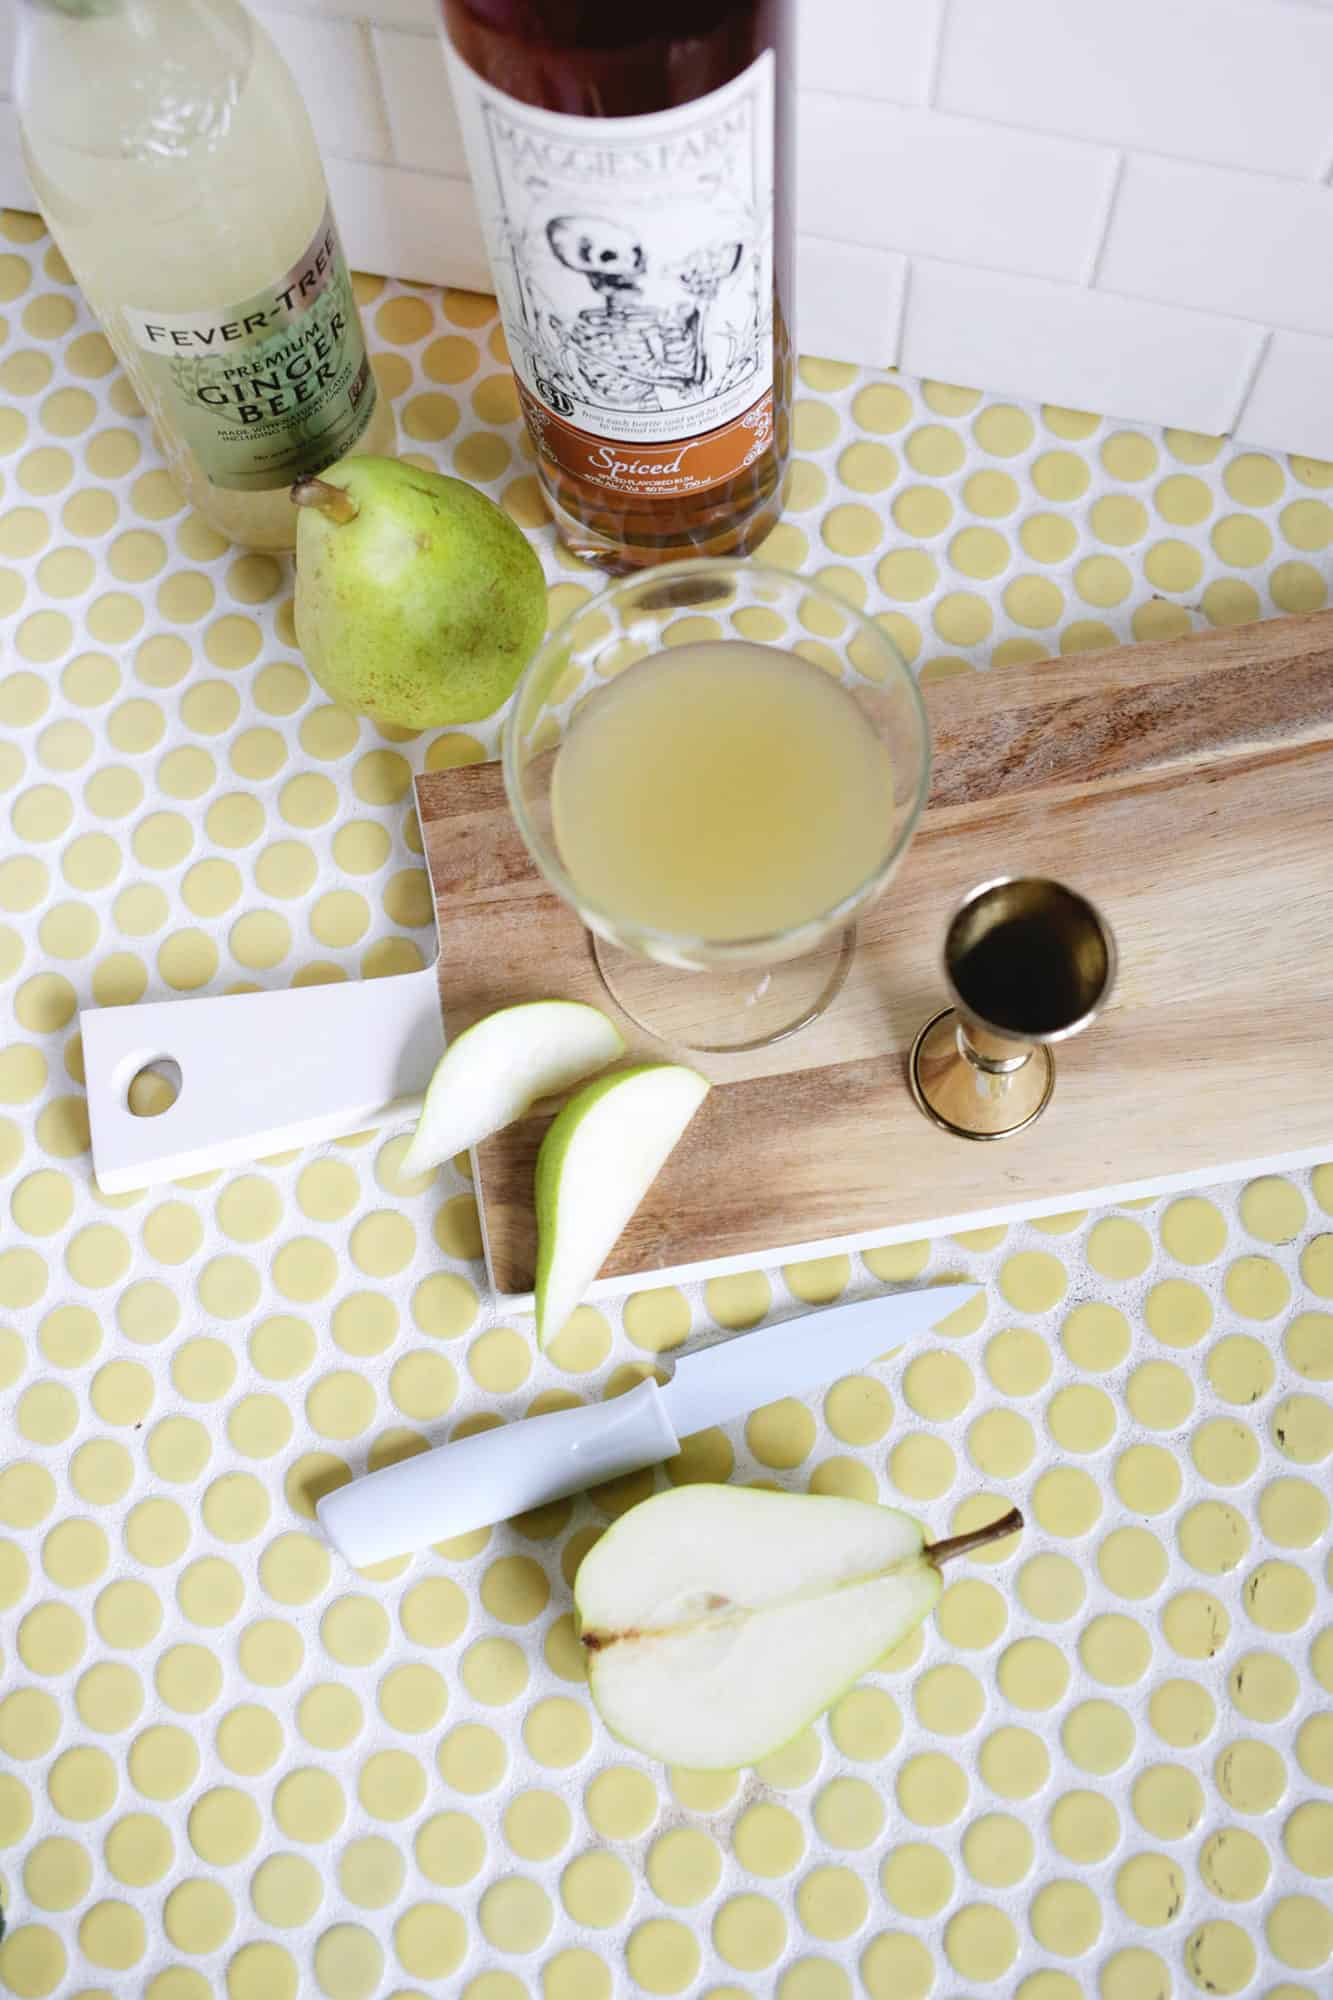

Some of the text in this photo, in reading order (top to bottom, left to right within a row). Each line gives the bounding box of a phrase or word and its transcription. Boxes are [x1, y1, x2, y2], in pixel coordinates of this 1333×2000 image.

[145, 228, 334, 347] FEVER-TREE
[197, 312, 345, 405] GINGER
[223, 323, 320, 381] PREMIUM
[238, 362, 336, 424] BEER
[588, 442, 699, 477] Spiced
